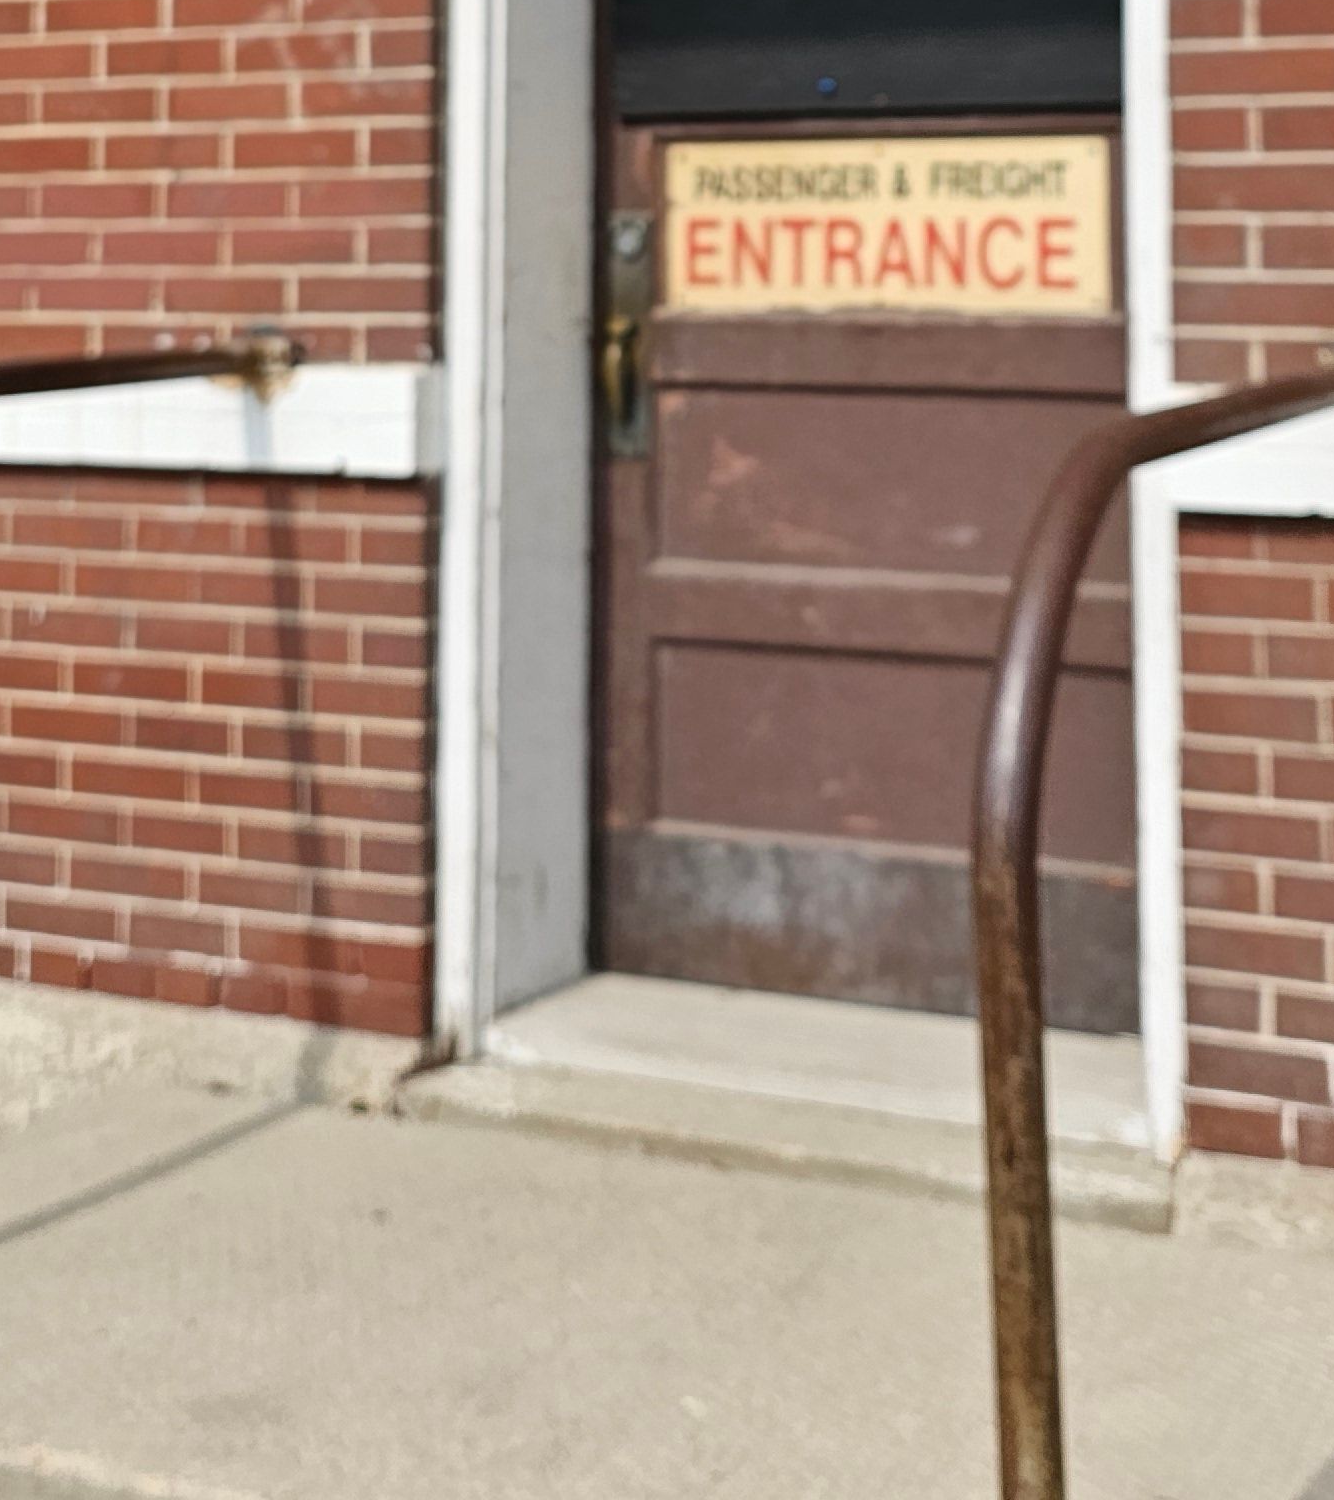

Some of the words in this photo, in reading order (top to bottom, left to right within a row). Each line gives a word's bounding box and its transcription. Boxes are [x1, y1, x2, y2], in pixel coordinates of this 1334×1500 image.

[693, 162, 879, 200] PASSENGER
[891, 163, 911, 198] &
[930, 159, 1068, 198] FREIGHT
[685, 216, 1078, 290] ENTRANCE
